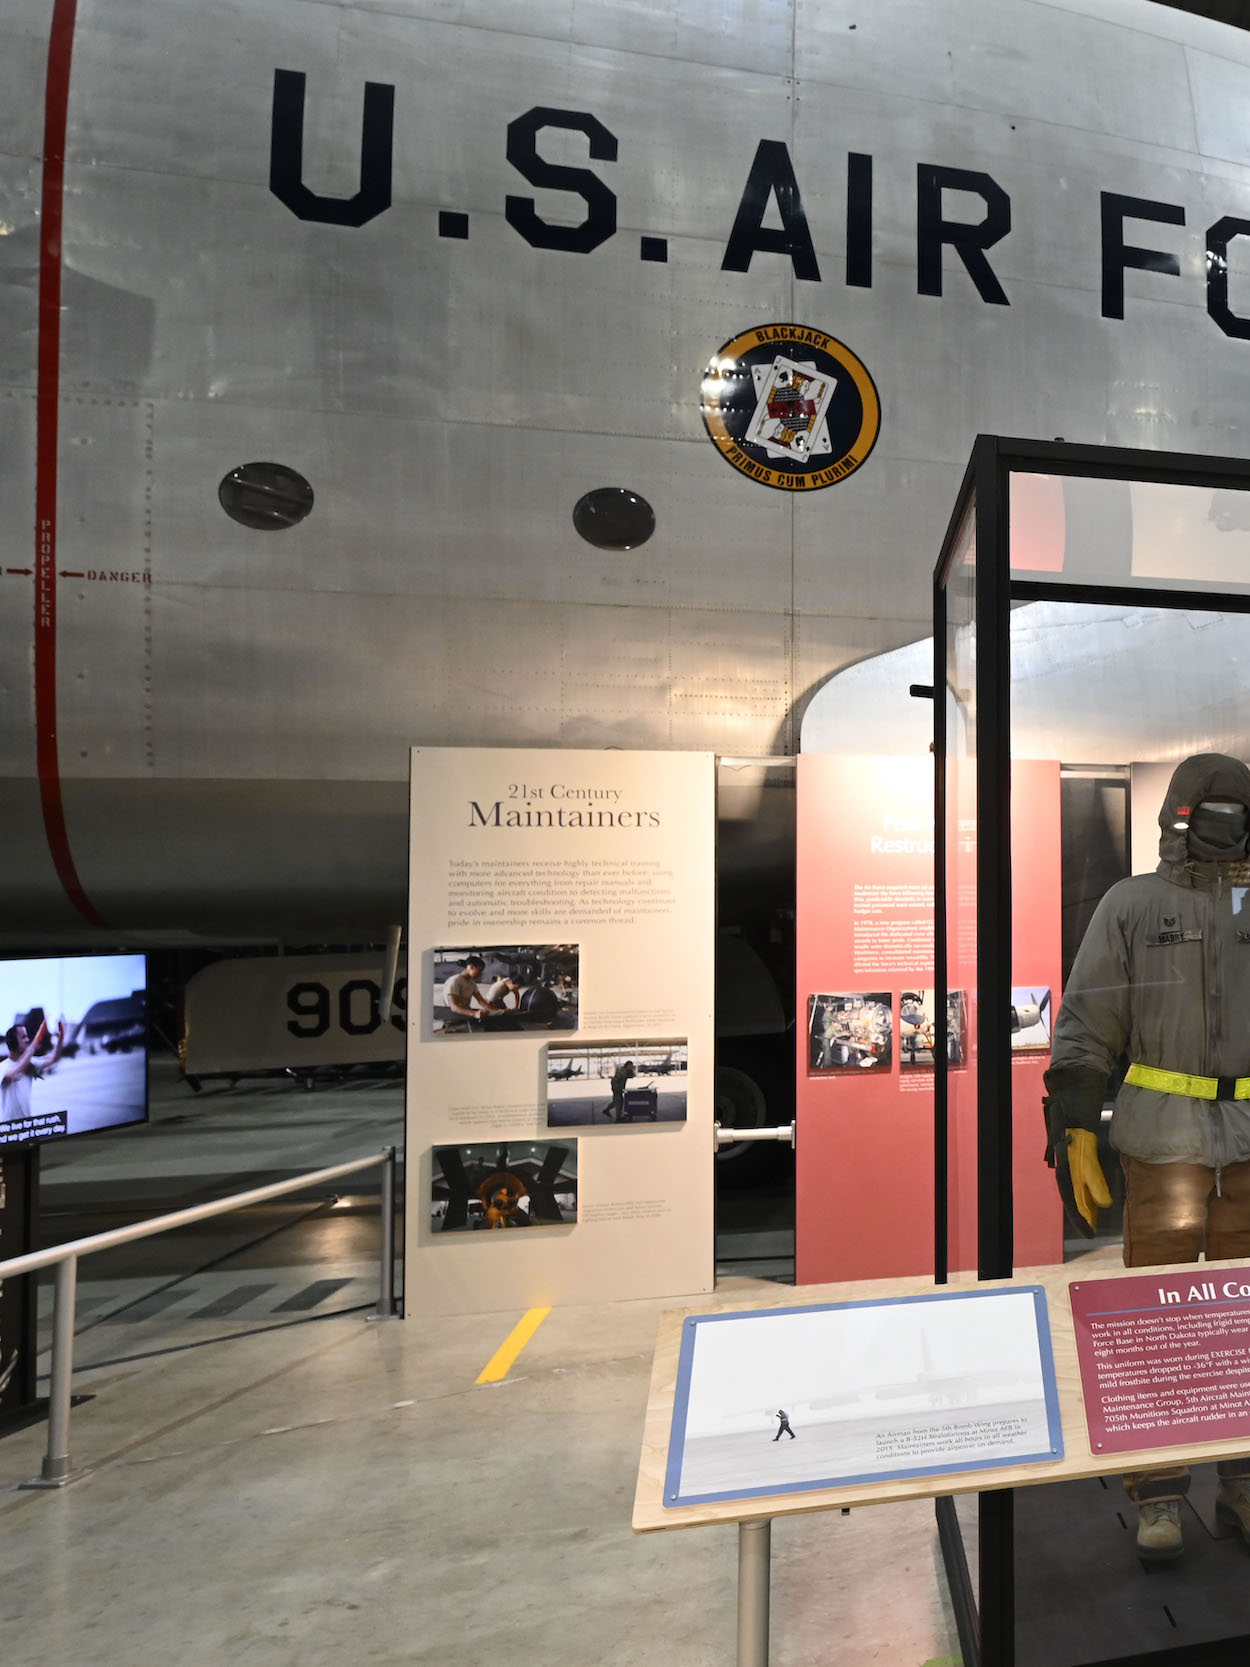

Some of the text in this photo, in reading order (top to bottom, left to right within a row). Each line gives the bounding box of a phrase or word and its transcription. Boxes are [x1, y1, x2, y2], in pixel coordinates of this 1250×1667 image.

[269, 68, 667, 262] U.S.
[721, 139, 1011, 306] AIR
[755, 327, 830, 350] BLACKJACK
[726, 447, 858, 487] PRIMUS CUM PLURIMI
[41, 520, 51, 627] PROPELLER
[87, 570, 152, 583] DANGER
[508, 784, 623, 804] 21st Century
[468, 801, 661, 827] Maintainers
[1158, 932, 1184, 943] MABRY
[8, 1133, 17, 1141] we
[18, 1130, 29, 1141] get
[30, 1129, 34, 1137] it
[35, 1127, 52, 1136] every
[11, 1122, 22, 1130] live
[23, 1120, 32, 1128] for
[33, 1118, 45, 1126] that
[1158, 1288, 1180, 1304] In
[1187, 1283, 1217, 1302] All
[1091, 1321, 1105, 1329] The
[1107, 1320, 1135, 1328] mission
[1137, 1316, 1164, 1325] doesn't
[1165, 1315, 1181, 1323] stop
[1183, 1313, 1203, 1321] when
[1204, 1309, 1250, 1319] temperatures
[1092, 1329, 1111, 1338] work
[1123, 1327, 1132, 1335] all
[1177, 1321, 1212, 1330] including
[1213, 1317, 1232, 1328] frigid
[1094, 1339, 1114, 1347] Force
[1116, 1337, 1134, 1345] Base
[1145, 1332, 1167, 1342] North
[1169, 1331, 1196, 1339] Dakota
[1197, 1327, 1229, 1338] typically
[1095, 1340, 1200, 1357] eight months out of the year.
[1097, 1362, 1112, 1370] This
[1114, 1359, 1145, 1368] uniform
[1184, 1353, 1209, 1361] during
[1211, 1347, 1246, 1358] EXERCISE
[953, 1422, 973, 1430] Bomb
[991, 1418, 1019, 1427] prepares
[876, 1437, 898, 1446] launch
[906, 1434, 927, 1442] B-52H
[979, 1426, 998, 1434] Minot
[1000, 1424, 1012, 1432] AFB
[955, 1436, 963, 1444] all
[1002, 1430, 1026, 1438] weather
[920, 1446, 945, 1456] provide
[947, 1444, 976, 1452] airpower
